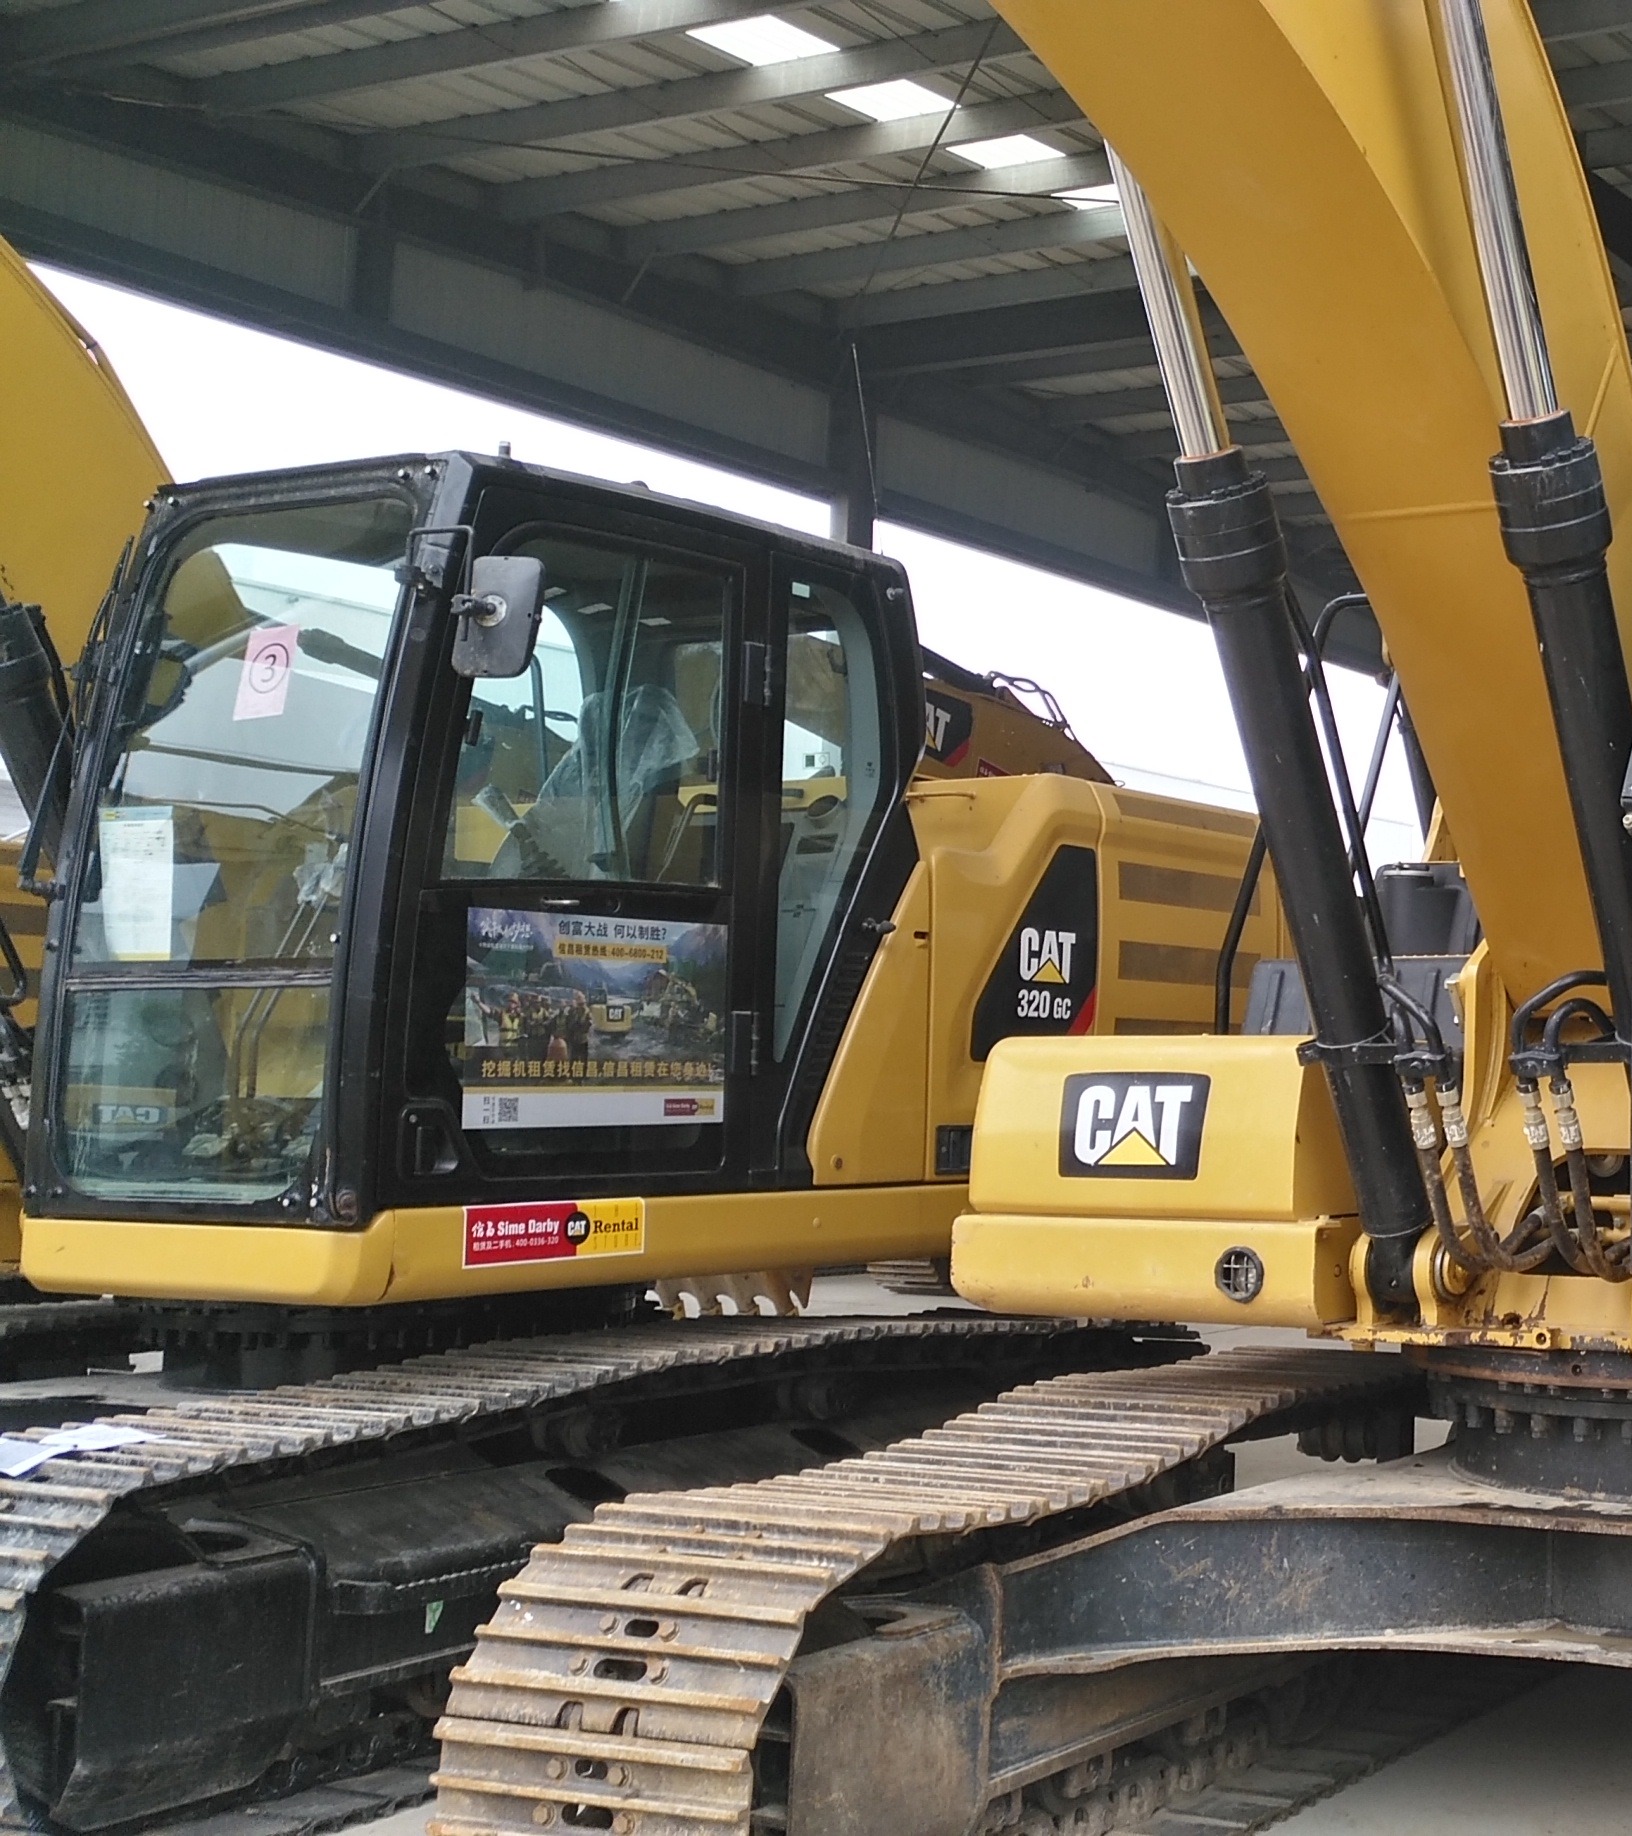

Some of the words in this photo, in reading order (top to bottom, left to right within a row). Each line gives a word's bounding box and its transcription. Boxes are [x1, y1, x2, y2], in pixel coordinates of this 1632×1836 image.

[558, 920, 608, 937] 创富大战
[1019, 926, 1076, 985] CAT
[1017, 990, 1050, 1019] 320
[1053, 998, 1071, 1020] GC
[1074, 1084, 1193, 1167] CAT
[497, 1220, 526, 1237] Sime
[528, 1217, 560, 1236] Darby
[567, 1220, 586, 1237] CAT
[592, 1217, 639, 1234] Rental
